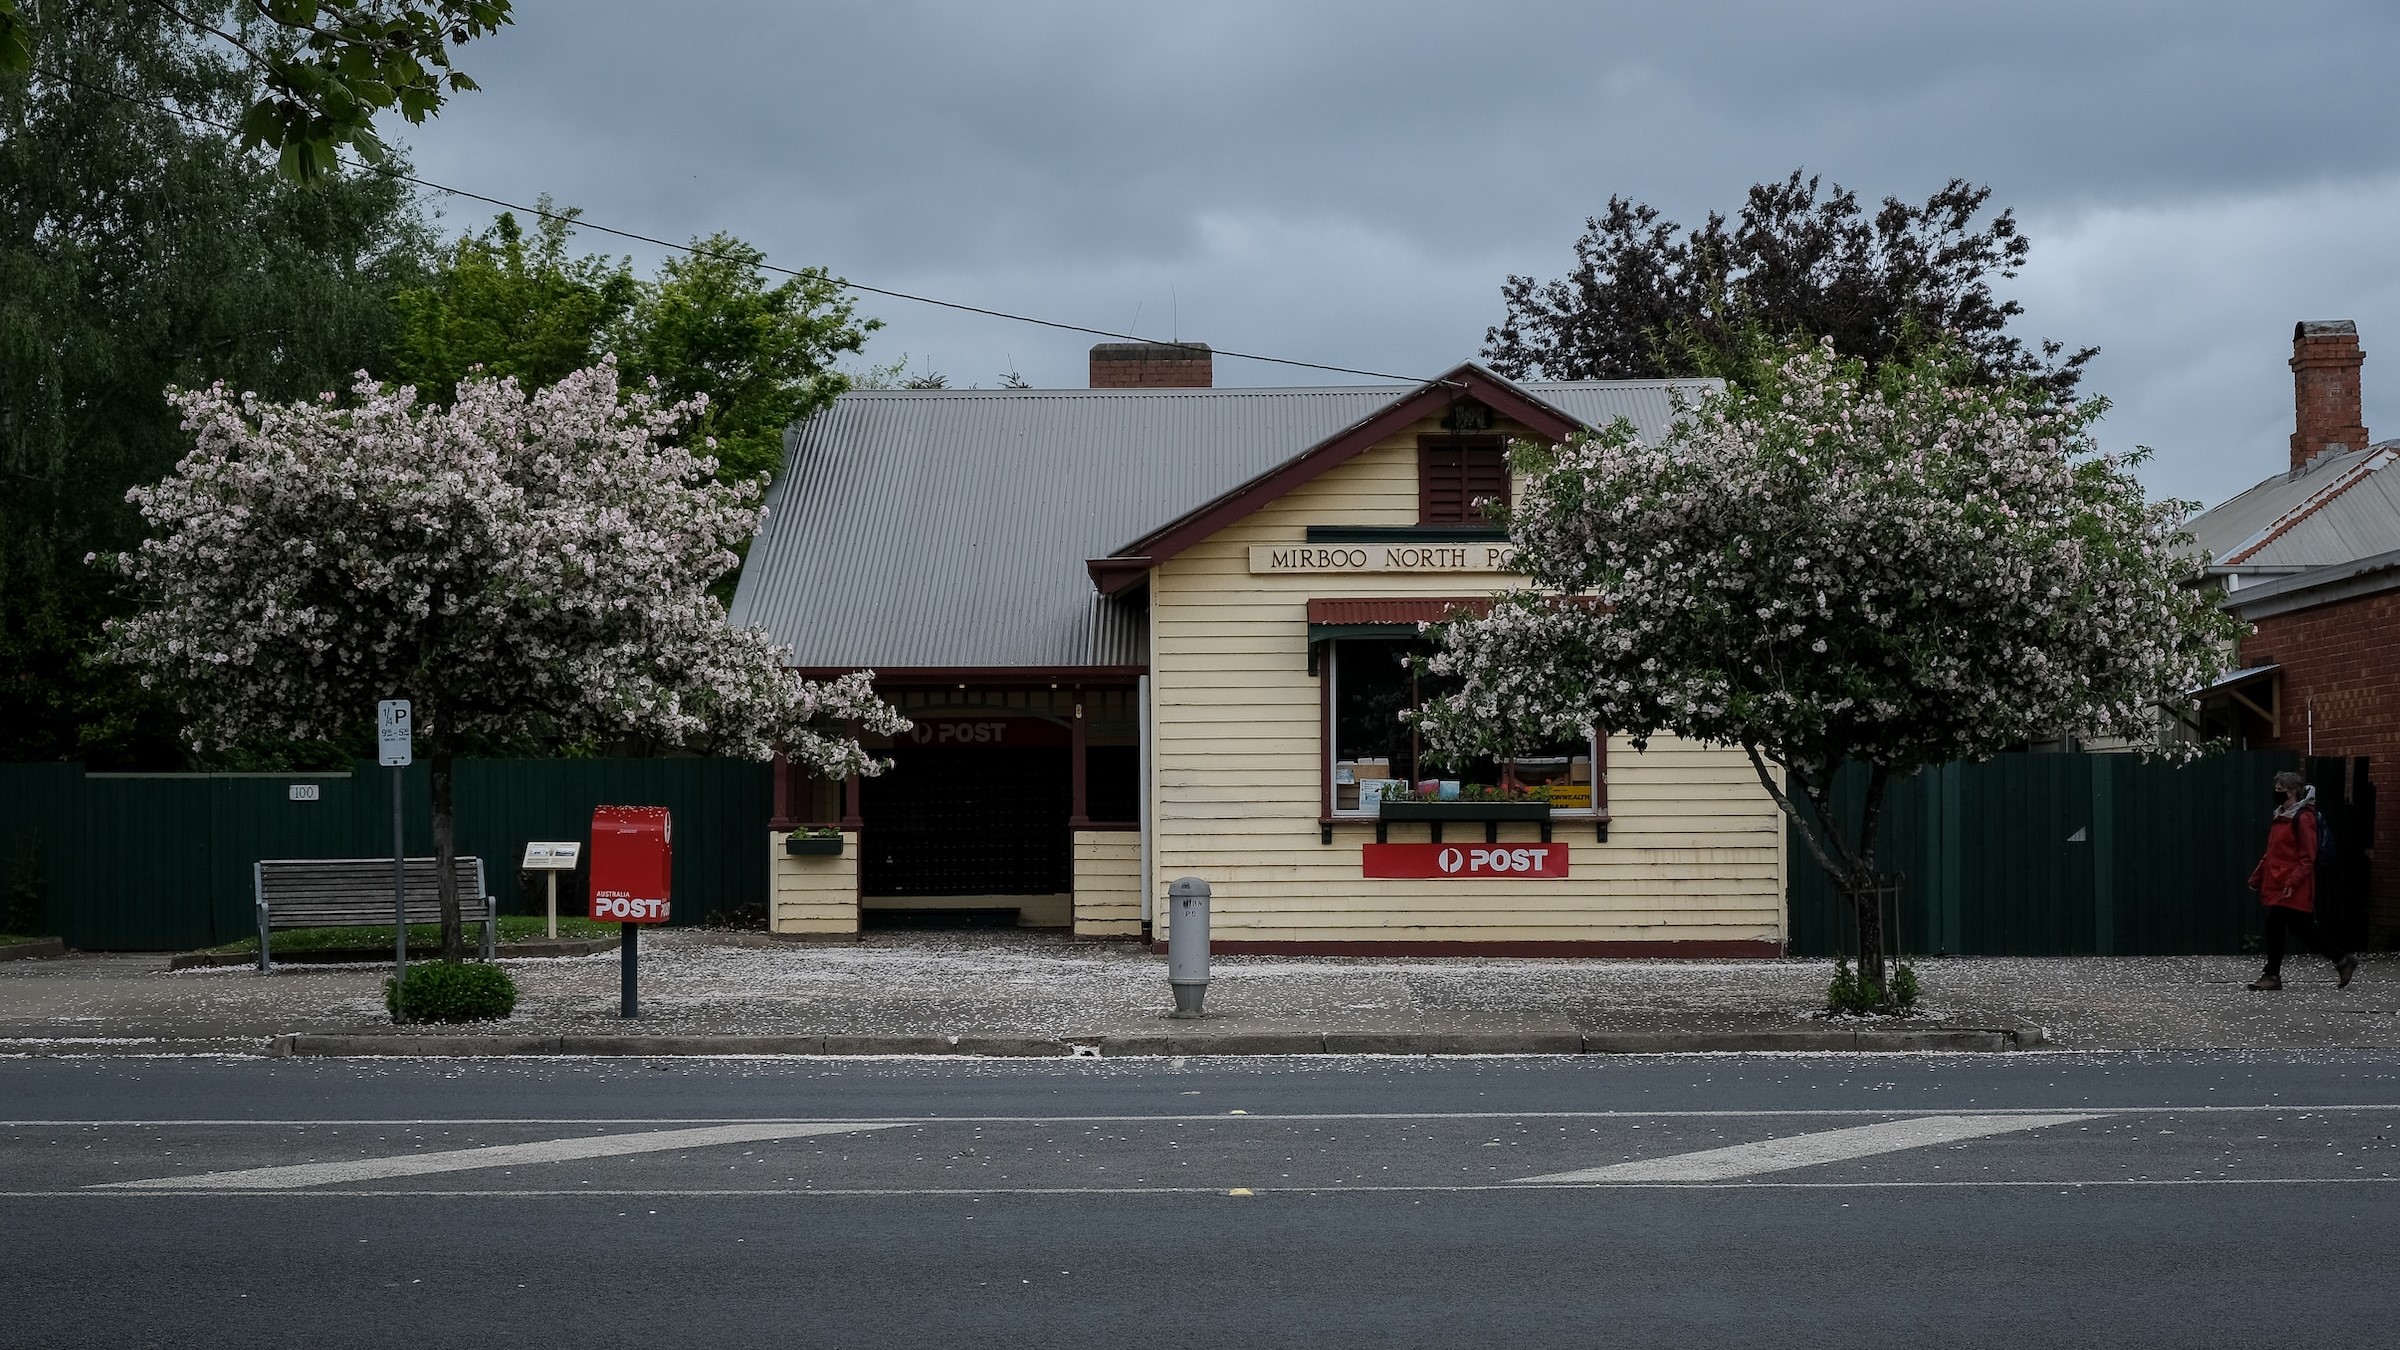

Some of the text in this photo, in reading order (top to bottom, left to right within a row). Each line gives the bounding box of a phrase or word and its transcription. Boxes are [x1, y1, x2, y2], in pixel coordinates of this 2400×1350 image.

[1271, 549, 1367, 568] MIRBOO
[1385, 548, 1466, 567] NORTH
[395, 709, 407, 724] P
[938, 722, 1007, 742] POST
[295, 786, 313, 798] 100
[1470, 848, 1549, 872] POST
[596, 890, 631, 898] AUSTRALIA
[595, 898, 662, 918] POST
